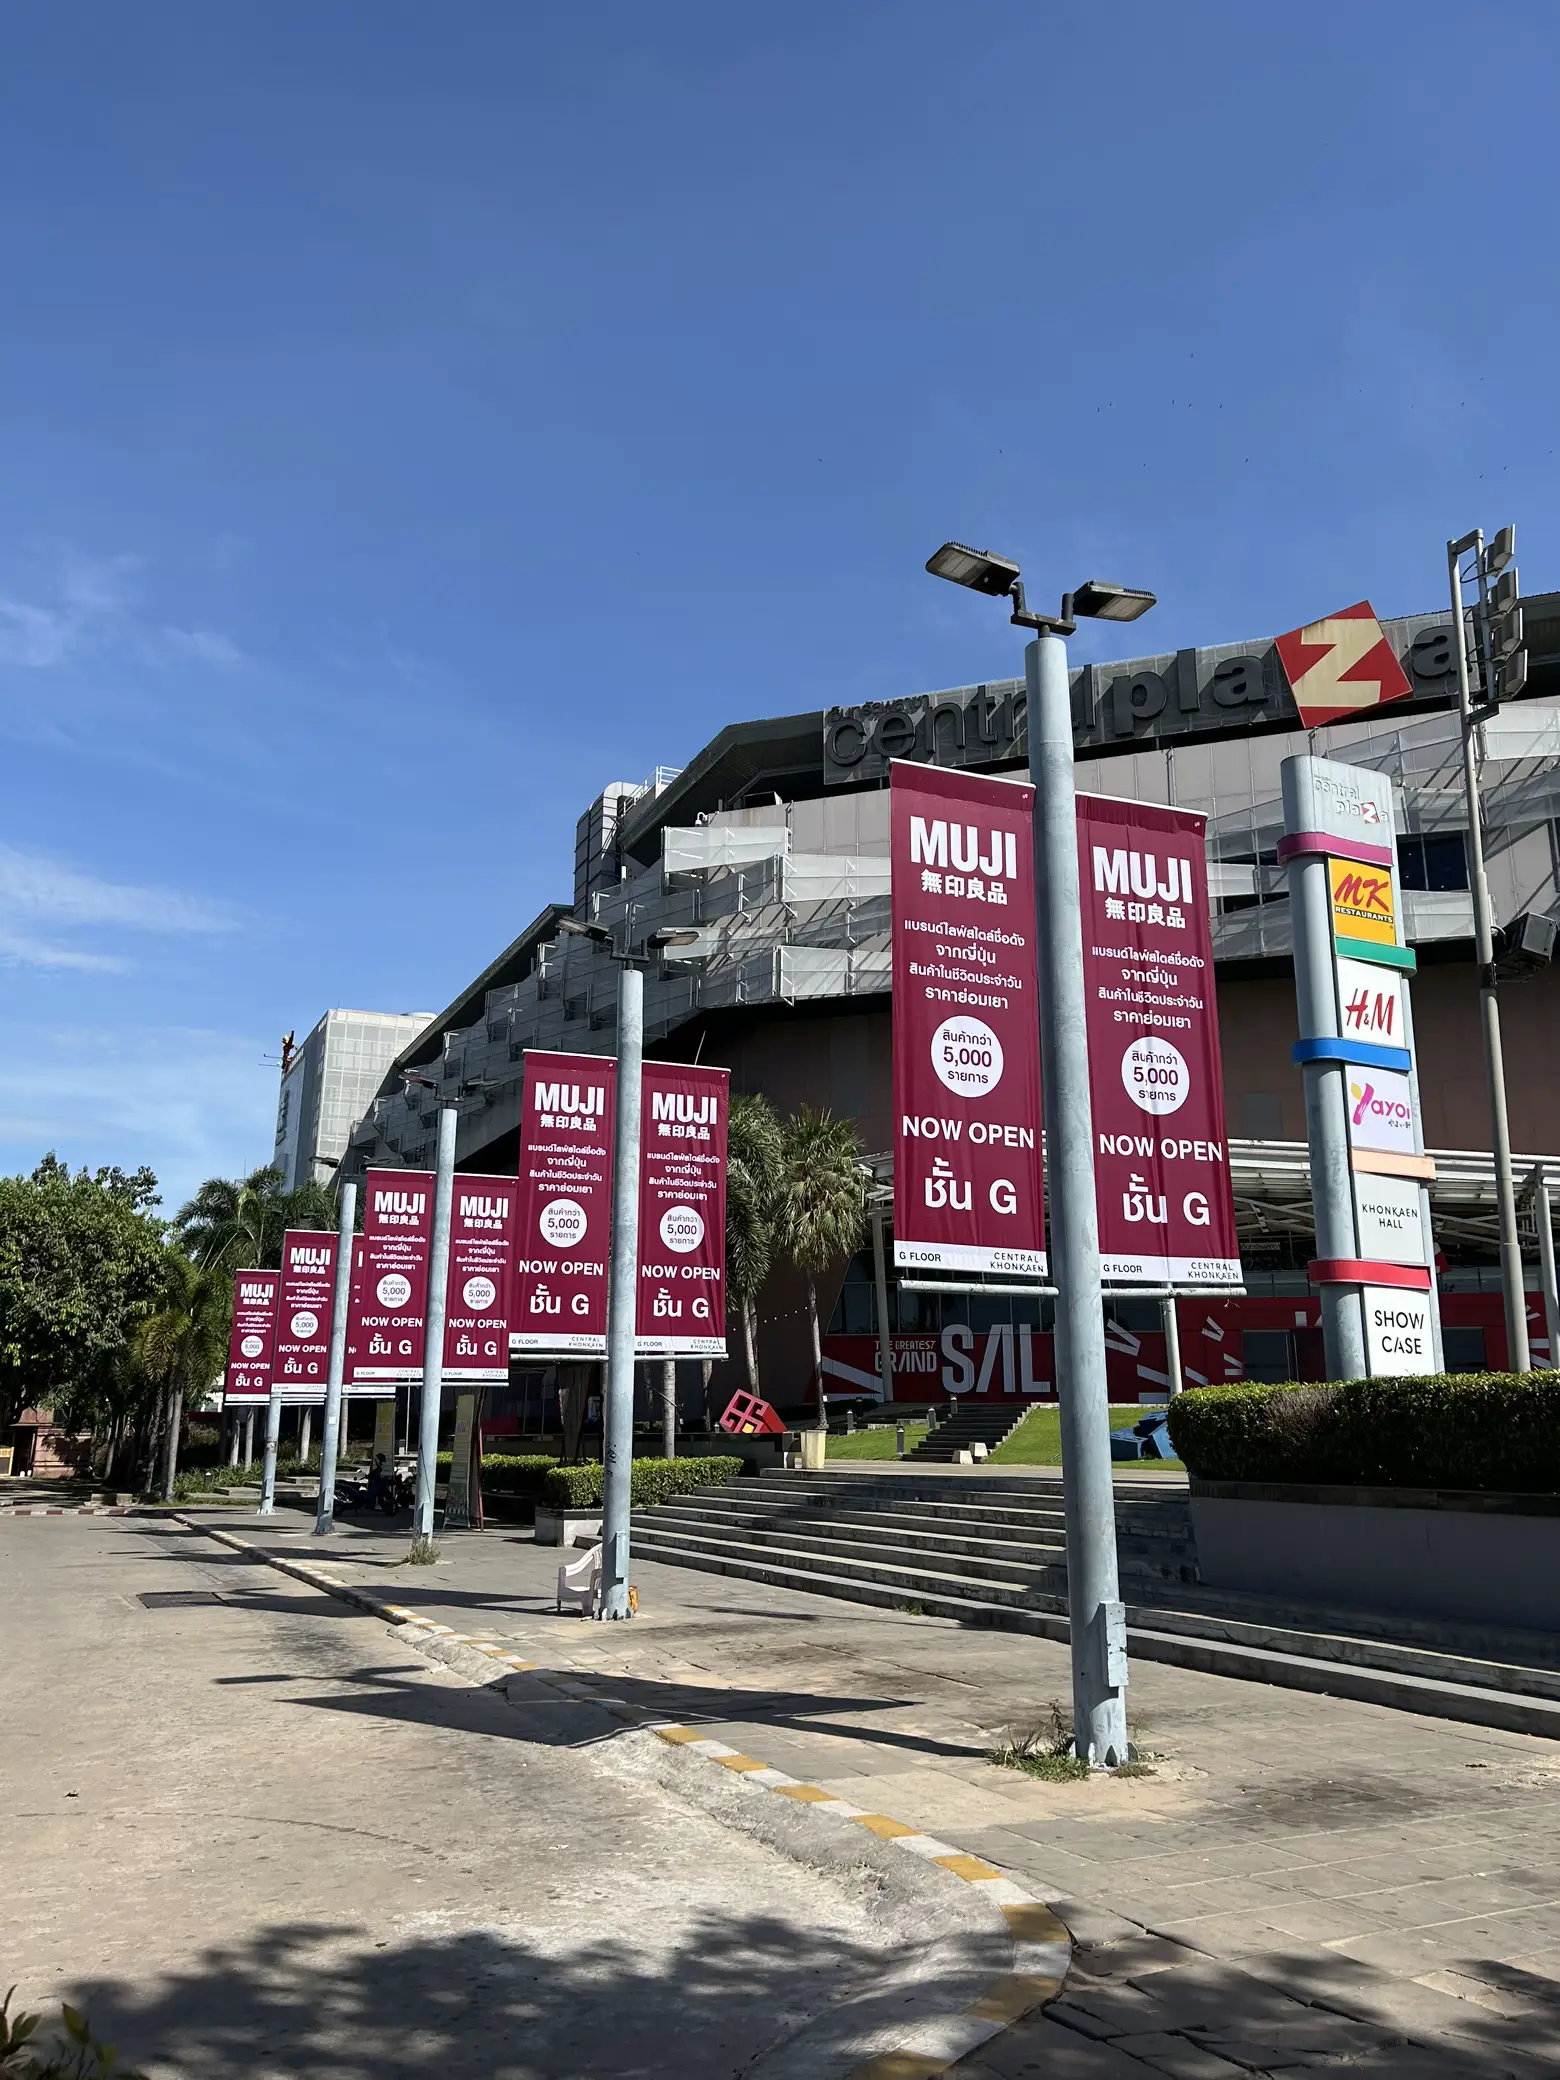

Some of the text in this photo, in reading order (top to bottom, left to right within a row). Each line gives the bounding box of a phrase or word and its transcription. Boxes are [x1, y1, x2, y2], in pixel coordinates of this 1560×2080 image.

[1314, 777, 1360, 800] central
[911, 816, 1016, 879] MUJI
[1093, 846, 1192, 904] MUJI
[921, 869, 1007, 905] 無印良品
[1334, 873, 1389, 912] MK
[1105, 897, 1185, 928] 無印良品
[1335, 906, 1393, 923] RESTAURANTS
[936, 944, 995, 966] จากญี่ปุ่น
[909, 962, 1021, 989] สินค้าในชีวิตประจำวัน
[1122, 968, 1177, 989] จากญี่ปุ่น
[926, 987, 1007, 1009] ราคาย่อมเยา
[1099, 987, 1203, 1009] สินค้าในชีวิตประจำวัน
[1114, 1010, 1191, 1028] ราคาย่อมเยา
[1345, 988, 1395, 1035] H&M
[942, 1029, 993, 1047] สินค้ากว่า
[944, 1046, 991, 1067] 5,000
[1131, 1050, 1178, 1066] สินค้ากว่า
[948, 1070, 988, 1083] รายการ
[1134, 1066, 1178, 1085] 5,000
[535, 1082, 604, 1115] MUJI
[1138, 1088, 1176, 1102] รายการ
[652, 1092, 717, 1124] MUJI
[540, 1113, 596, 1131] 無印良品
[658, 1123, 710, 1140] 無印良品
[903, 1115, 1033, 1148] NOW OPEN
[1099, 1134, 1222, 1161] NOW OPEN
[925, 1157, 1016, 1214] ชั้น G
[374, 1191, 425, 1213] MUJI
[460, 1196, 508, 1218] MUJI
[1123, 1173, 1210, 1225] ชั้น G
[1362, 1204, 1418, 1218] KHONKAEN
[548, 1218, 579, 1229] 5,000
[667, 1224, 696, 1235] 5,000
[1379, 1218, 1403, 1229] HALL
[290, 1247, 330, 1265] MUJI
[899, 1251, 940, 1261] G FLOOR
[994, 1252, 1038, 1263] CENTRAL
[519, 1260, 603, 1275] NOW OPEN
[642, 1265, 720, 1280] NOW OPEN
[990, 1262, 1043, 1272] KHONKAEN
[1113, 1265, 1142, 1273] FLOOR
[1188, 1270, 1240, 1281] KHONKAEN
[1191, 1262, 1233, 1271] CENTRAL
[240, 1283, 273, 1297] MUJI
[382, 1287, 405, 1295] 5,000
[469, 1289, 490, 1297] 5,000
[530, 1284, 589, 1314] ชั้น G
[653, 1288, 708, 1318] ชั้น G
[361, 1317, 422, 1327] NOW OPEN
[449, 1318, 506, 1328] NOW OPEN
[1374, 1310, 1424, 1330] SHOW
[399, 1340, 411, 1354] G
[484, 1341, 496, 1355] G
[875, 1341, 936, 1350] TE GREATEST
[1382, 1336, 1422, 1355] CASE
[941, 1323, 1058, 1393] SAL
[307, 1362, 317, 1373] G
[254, 1377, 262, 1386] G
